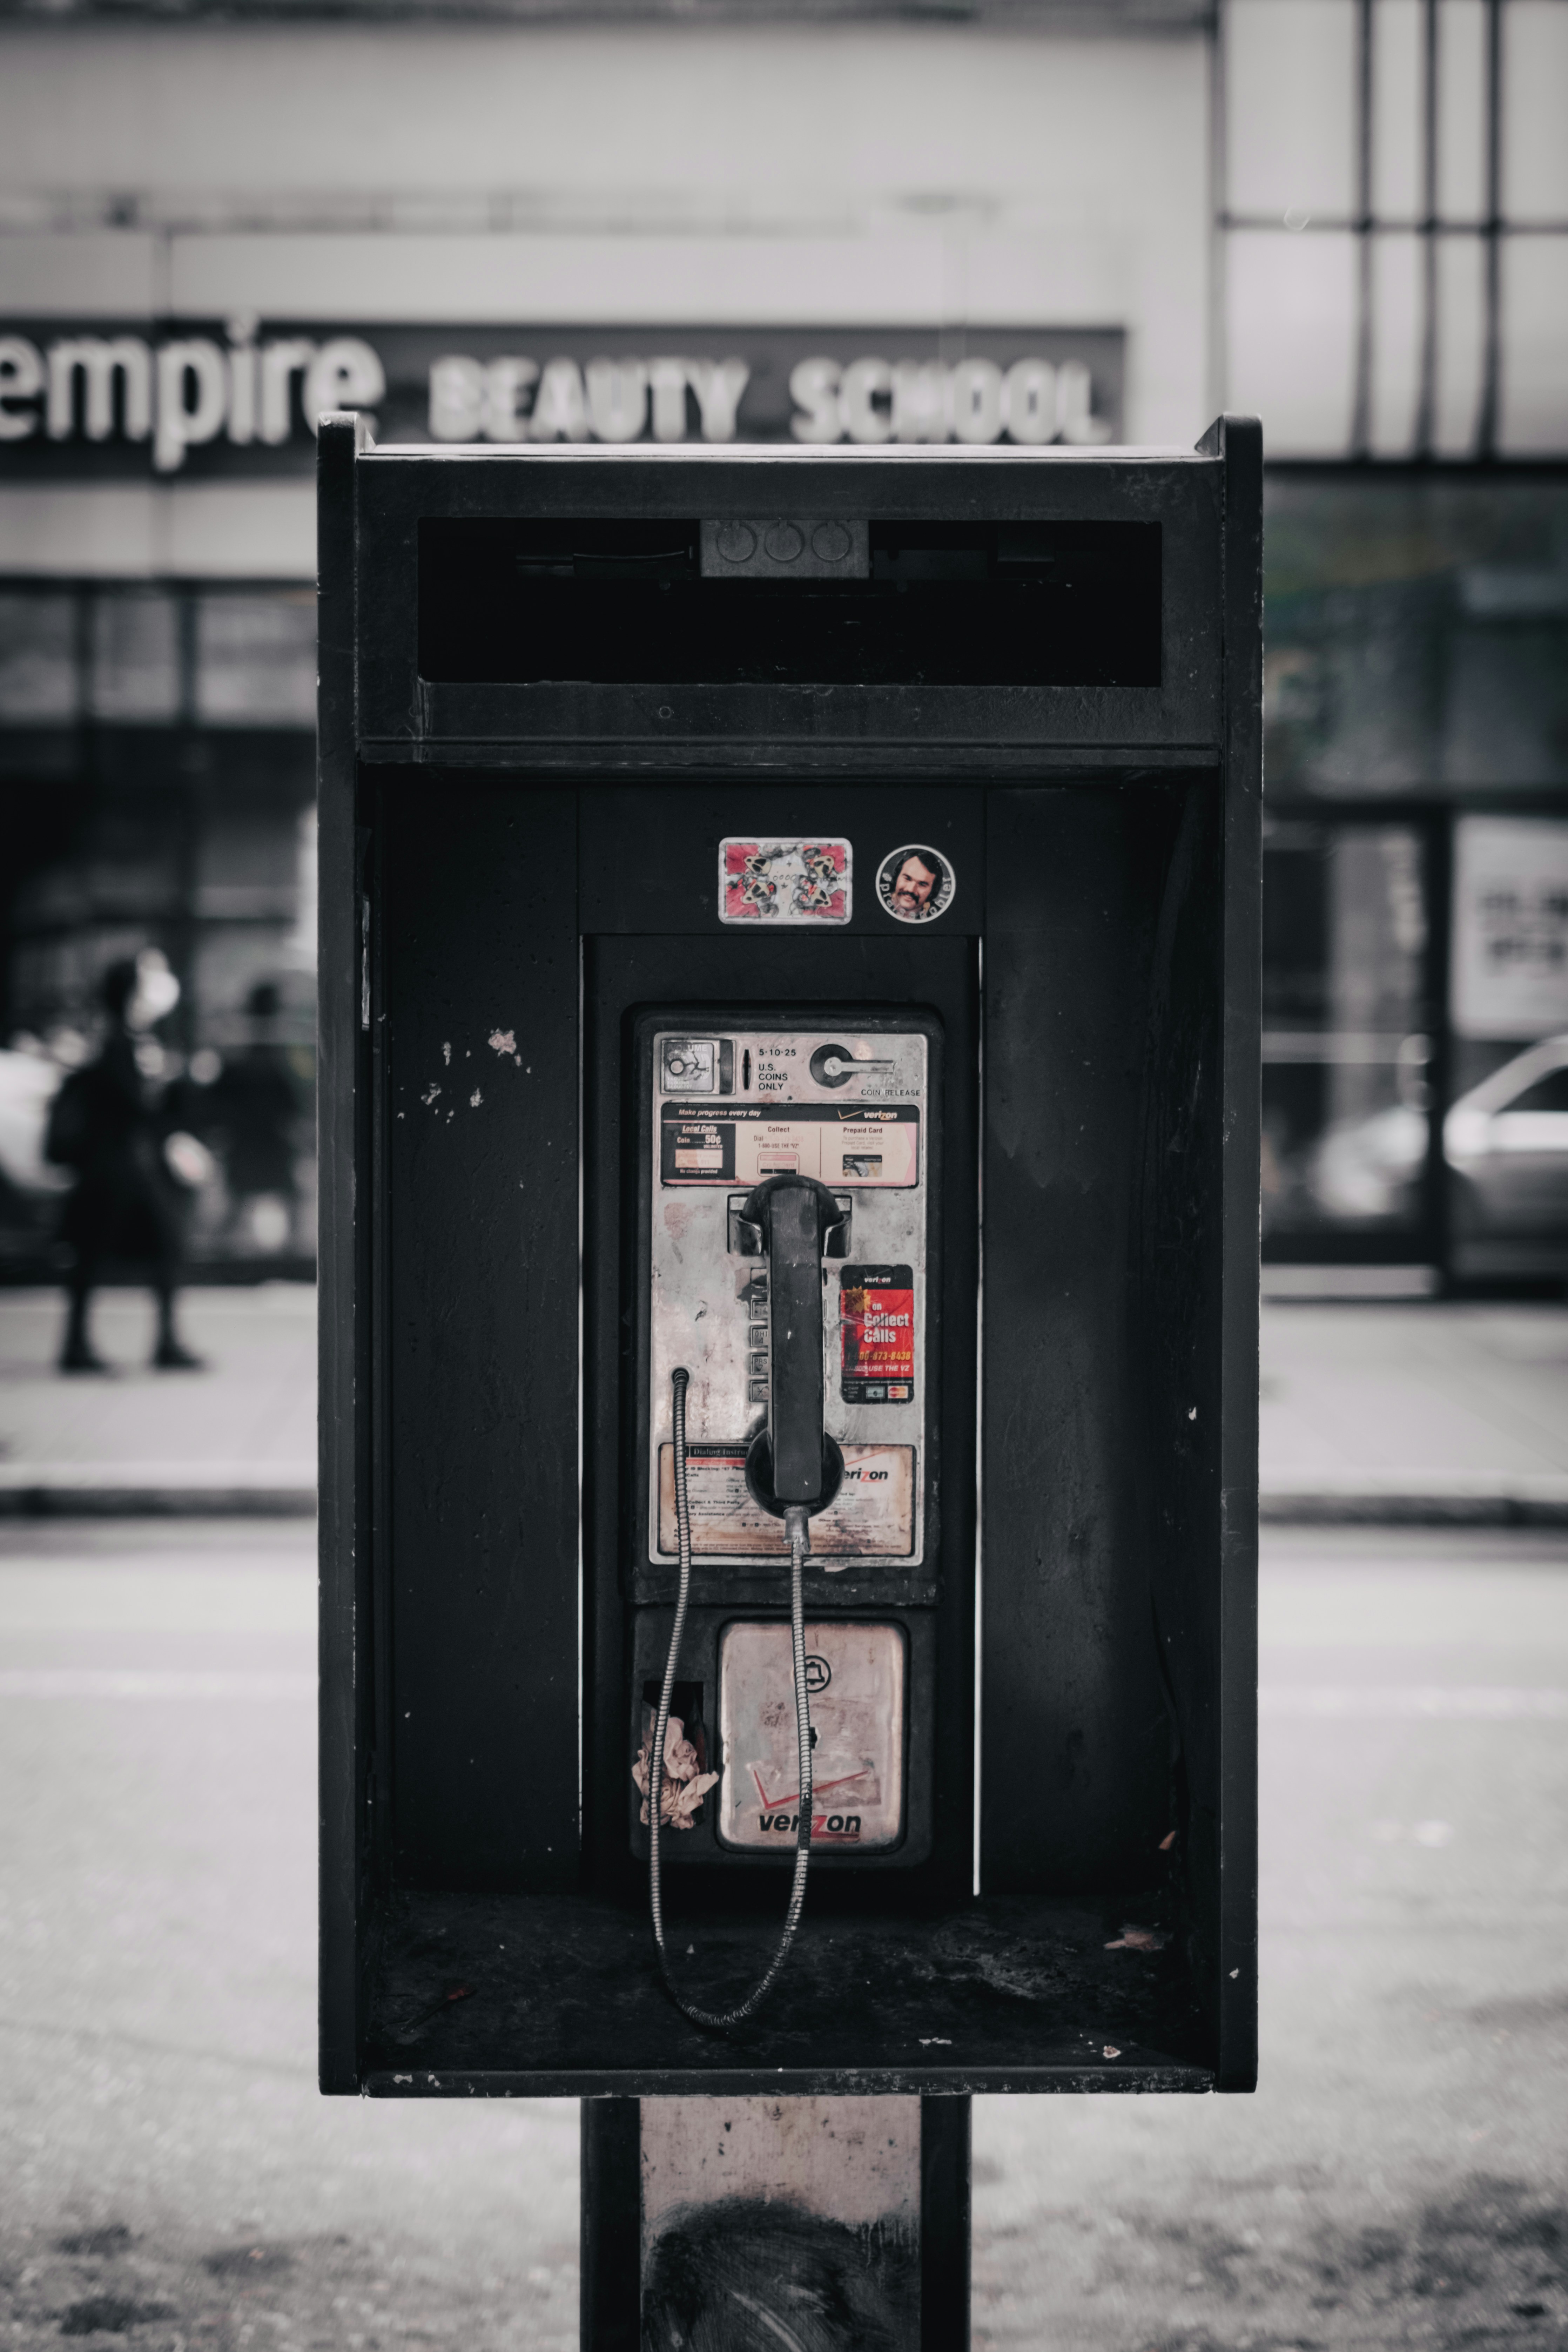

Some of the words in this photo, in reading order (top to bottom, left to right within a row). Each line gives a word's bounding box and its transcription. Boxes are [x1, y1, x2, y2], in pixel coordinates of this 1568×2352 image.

[0, 309, 386, 472] empire
[429, 356, 749, 443] BEAUTY
[789, 357, 1112, 444] SCHOOL
[864, 1111, 897, 1120] verizon
[682, 1125, 700, 1133] Local
[701, 1125, 717, 1133] Calls
[864, 1313, 909, 1327] Collect
[864, 1328, 896, 1343] Calls
[844, 1468, 888, 1482] erizon
[759, 1814, 861, 1838] verzon
